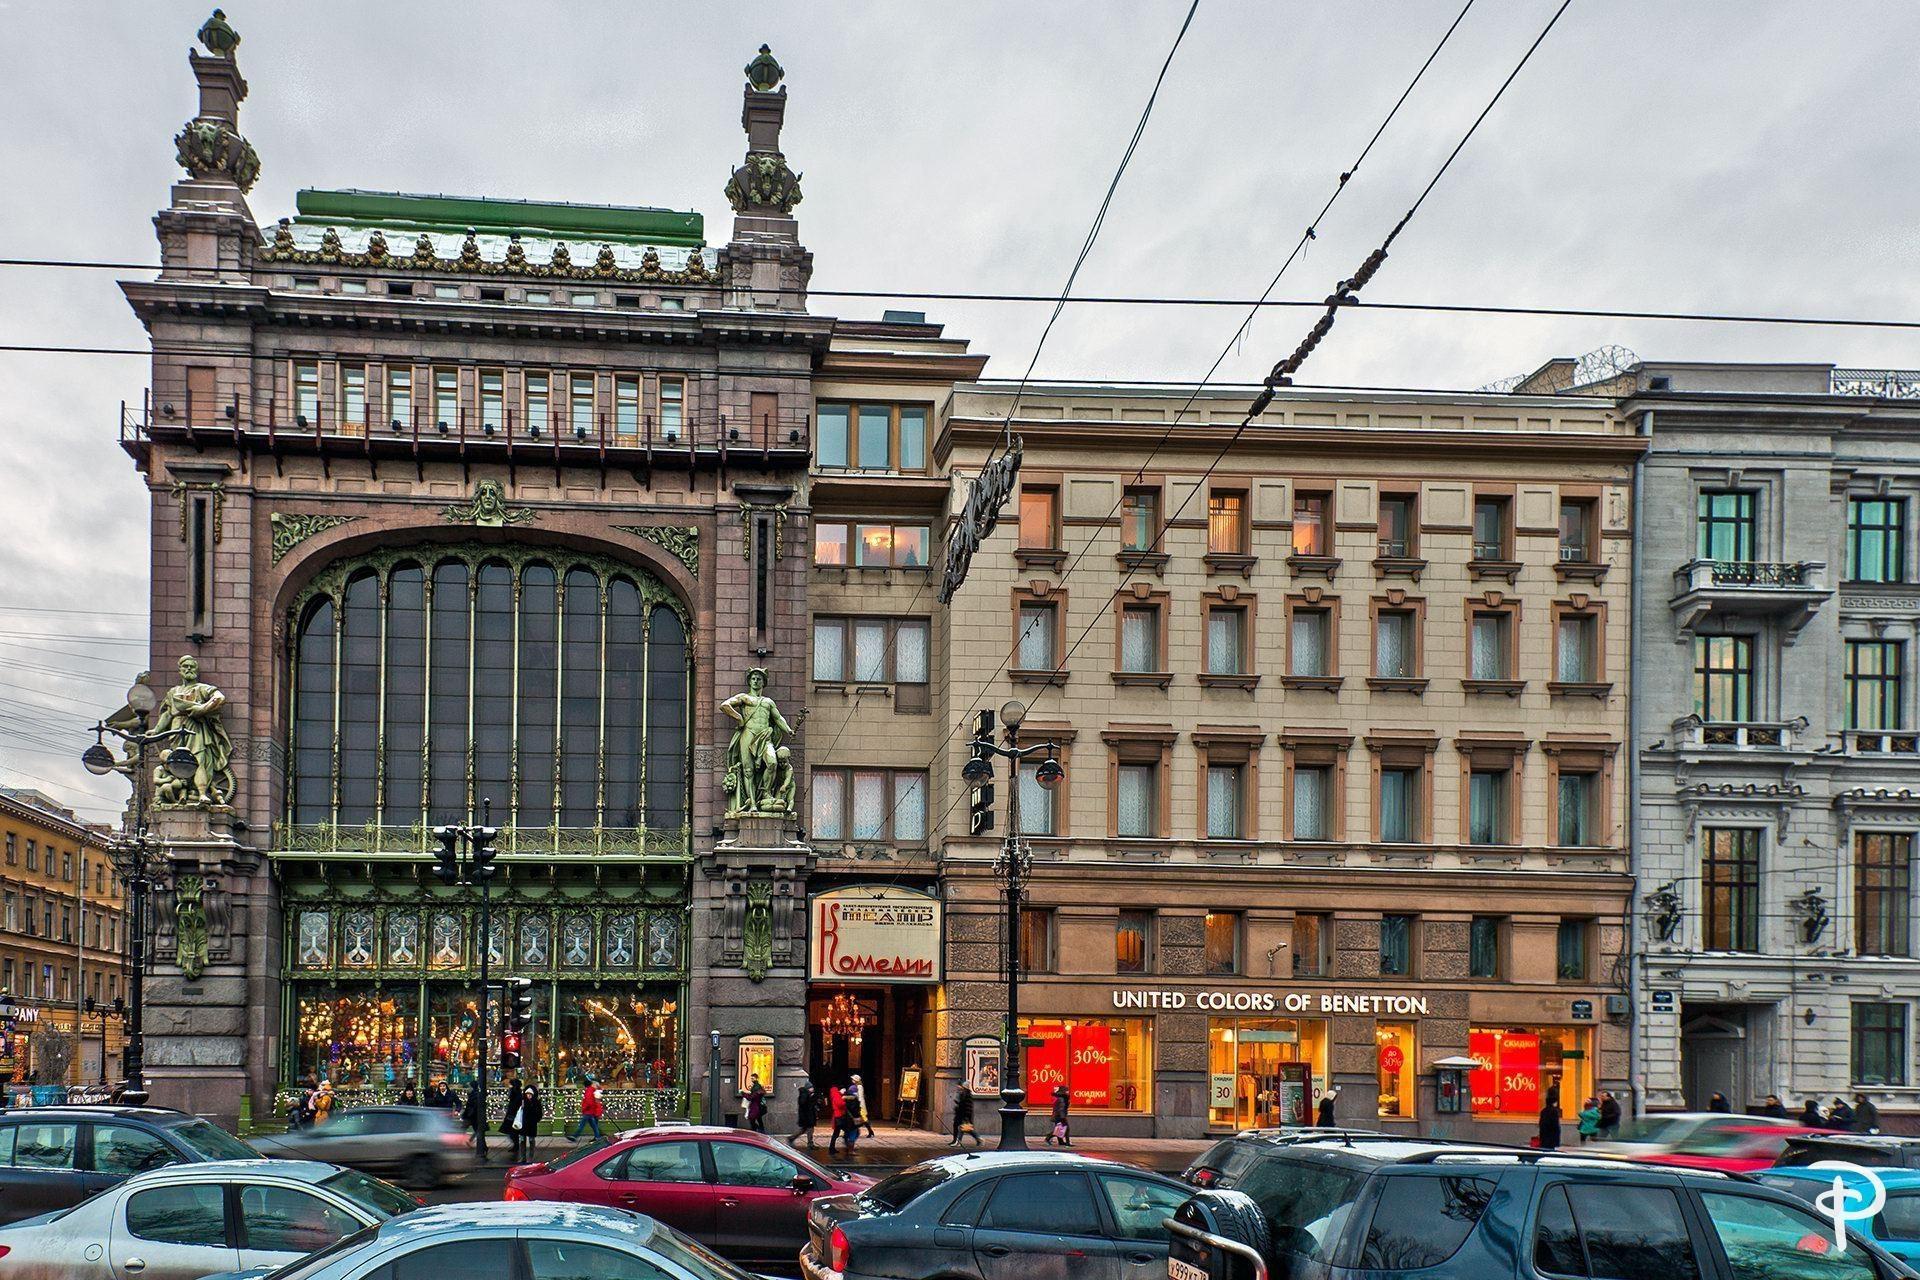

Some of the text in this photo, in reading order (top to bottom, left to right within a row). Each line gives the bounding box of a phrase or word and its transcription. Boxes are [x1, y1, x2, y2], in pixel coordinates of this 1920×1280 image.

[1112, 990, 1186, 1009] UNITED
[1196, 991, 1275, 1011] COLORS
[1284, 993, 1312, 1012] OF
[1032, 1031, 1064, 1039] СКИДКИ
[1503, 1040, 1536, 1048] СКИДКИ
[1073, 1050, 1106, 1065] 30%
[1382, 1057, 1402, 1067] 30%
[1031, 1069, 1064, 1083] 30%
[1503, 1076, 1536, 1092] 30%
[1074, 1090, 1106, 1098] СКИДКИ
